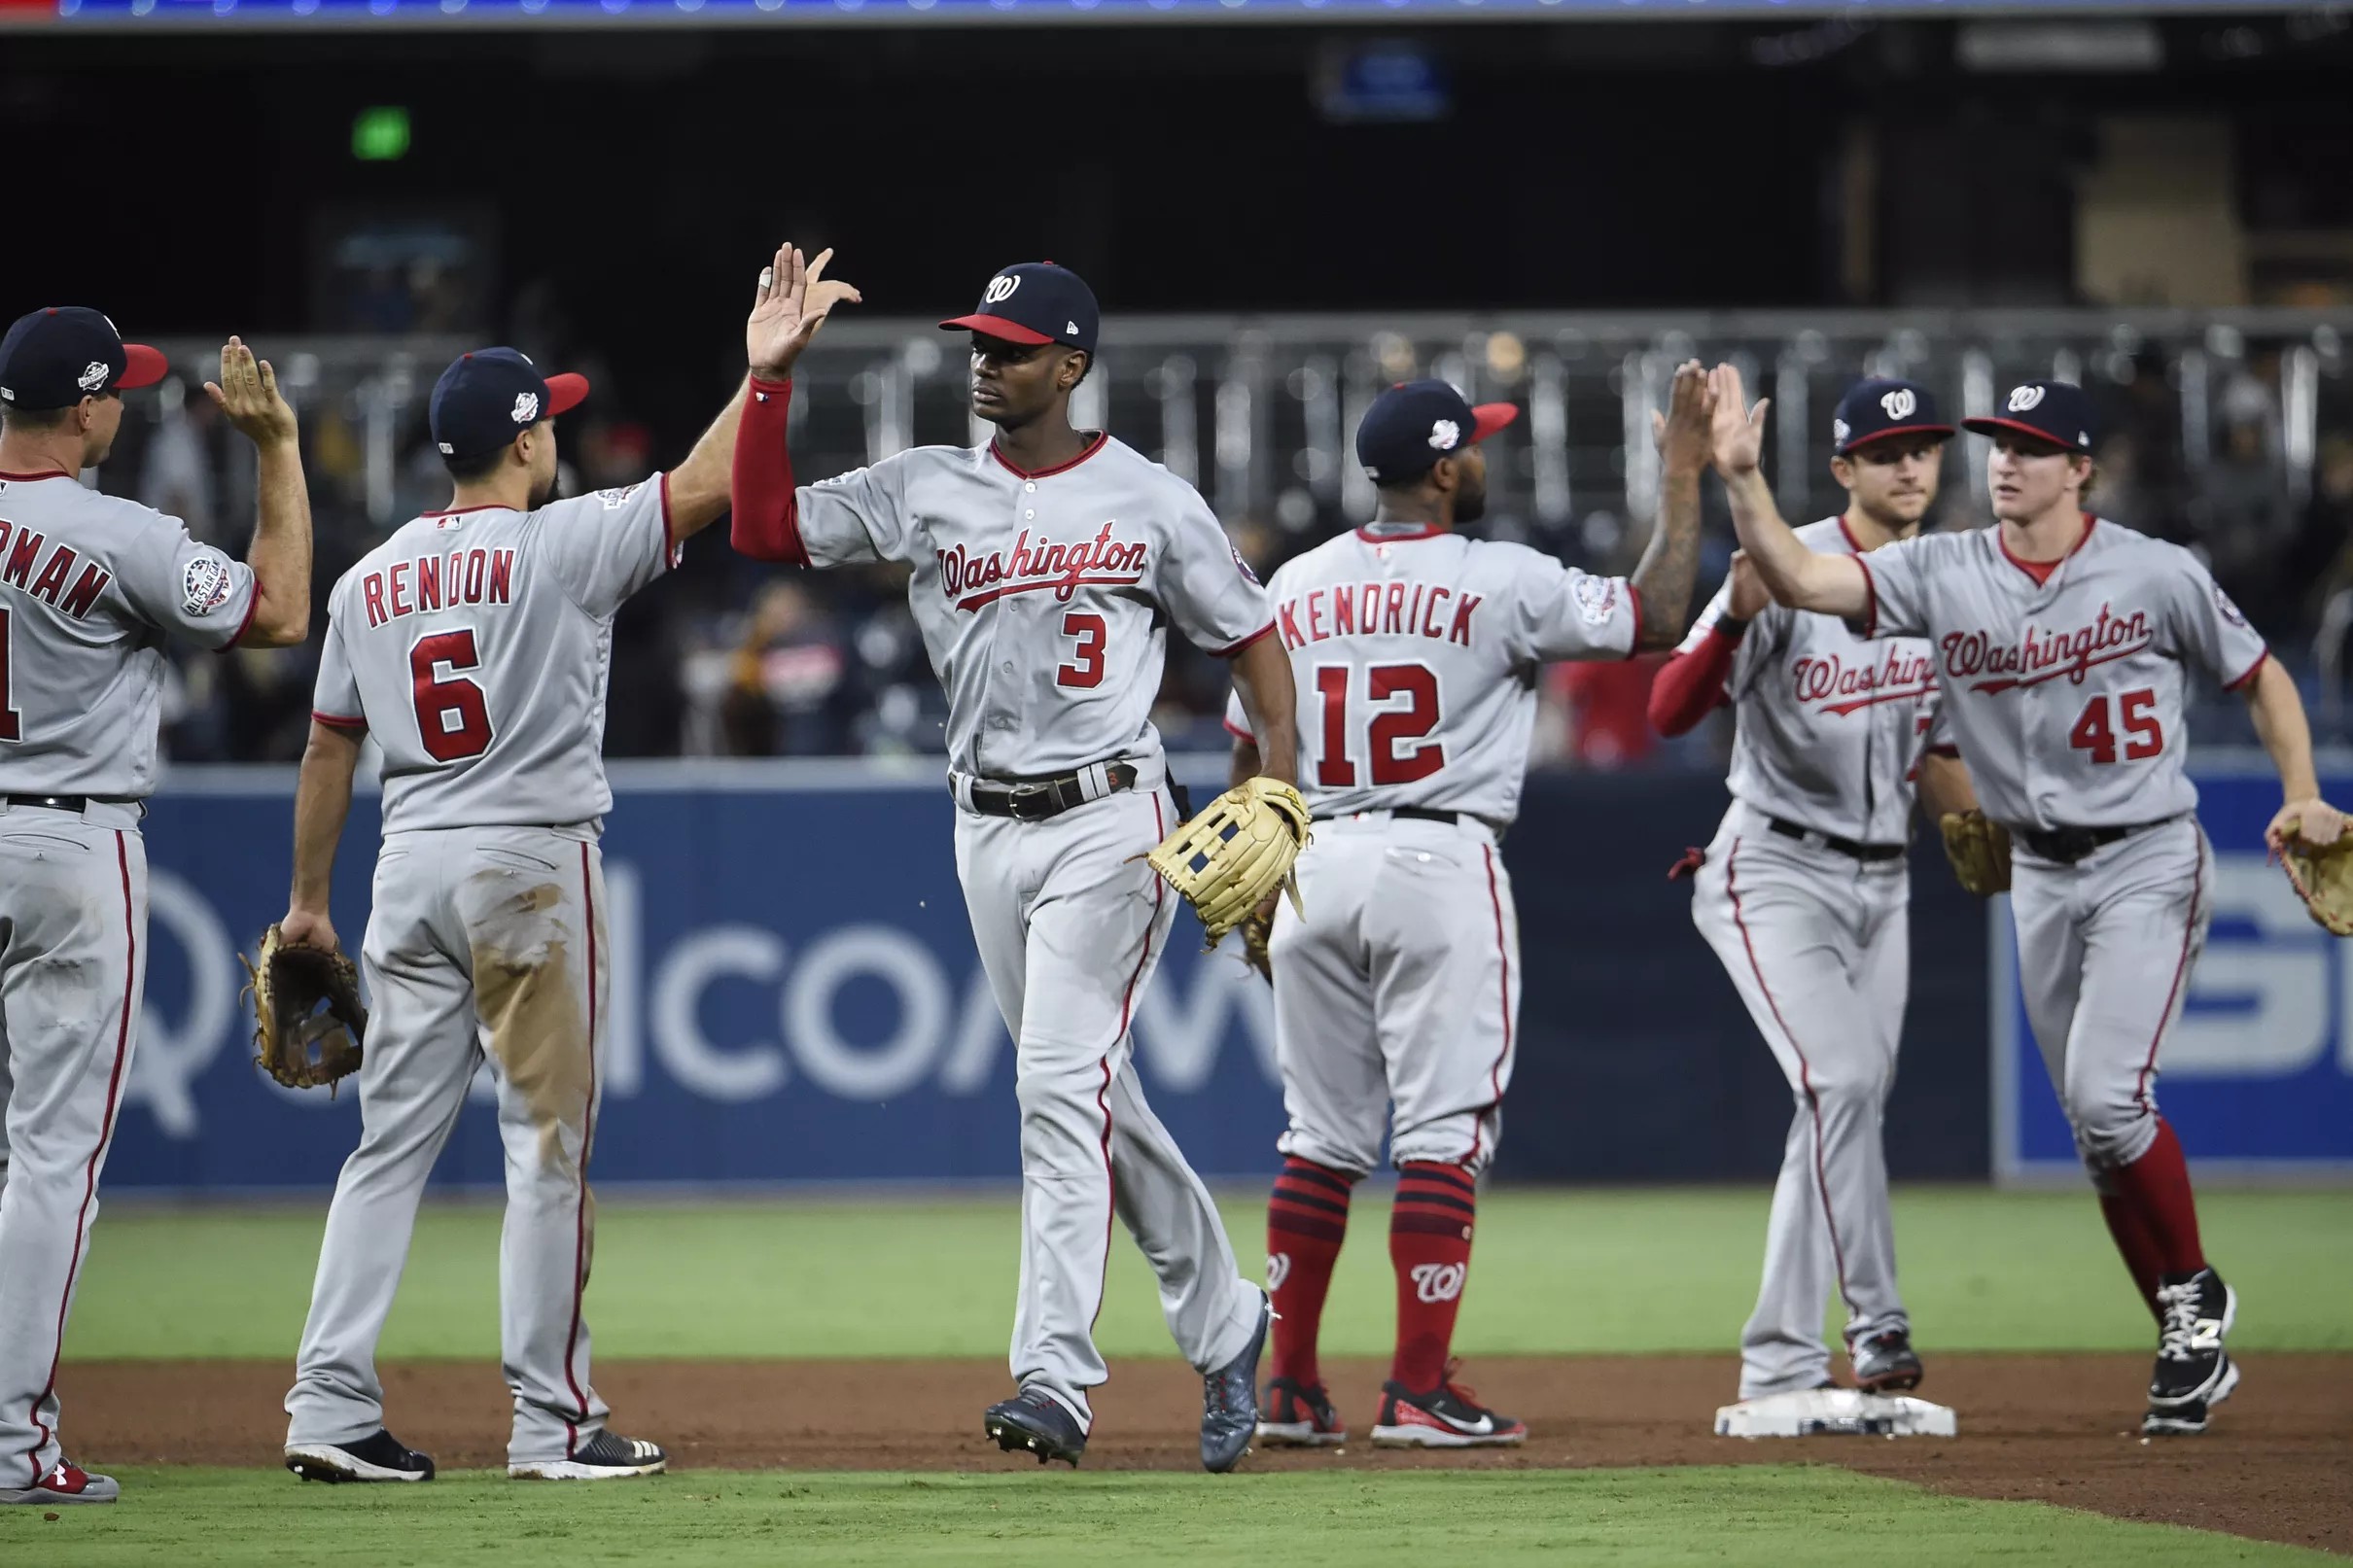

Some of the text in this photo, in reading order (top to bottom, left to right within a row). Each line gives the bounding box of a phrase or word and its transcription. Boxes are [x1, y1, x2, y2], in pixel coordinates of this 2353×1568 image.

[986, 275, 1021, 303] W
[1880, 389, 1916, 420] W
[2008, 385, 2046, 412] W
[363, 547, 514, 630] RENDON
[936, 519, 1147, 605] Washington
[1055, 611, 1106, 690] 3
[1278, 581, 1486, 651] KENDRICK
[1941, 601, 2153, 684] Washington
[408, 627, 496, 765] 6
[1313, 658, 1447, 788] 12
[2067, 685, 2164, 764] 45
[1411, 1261, 1465, 1303] W
